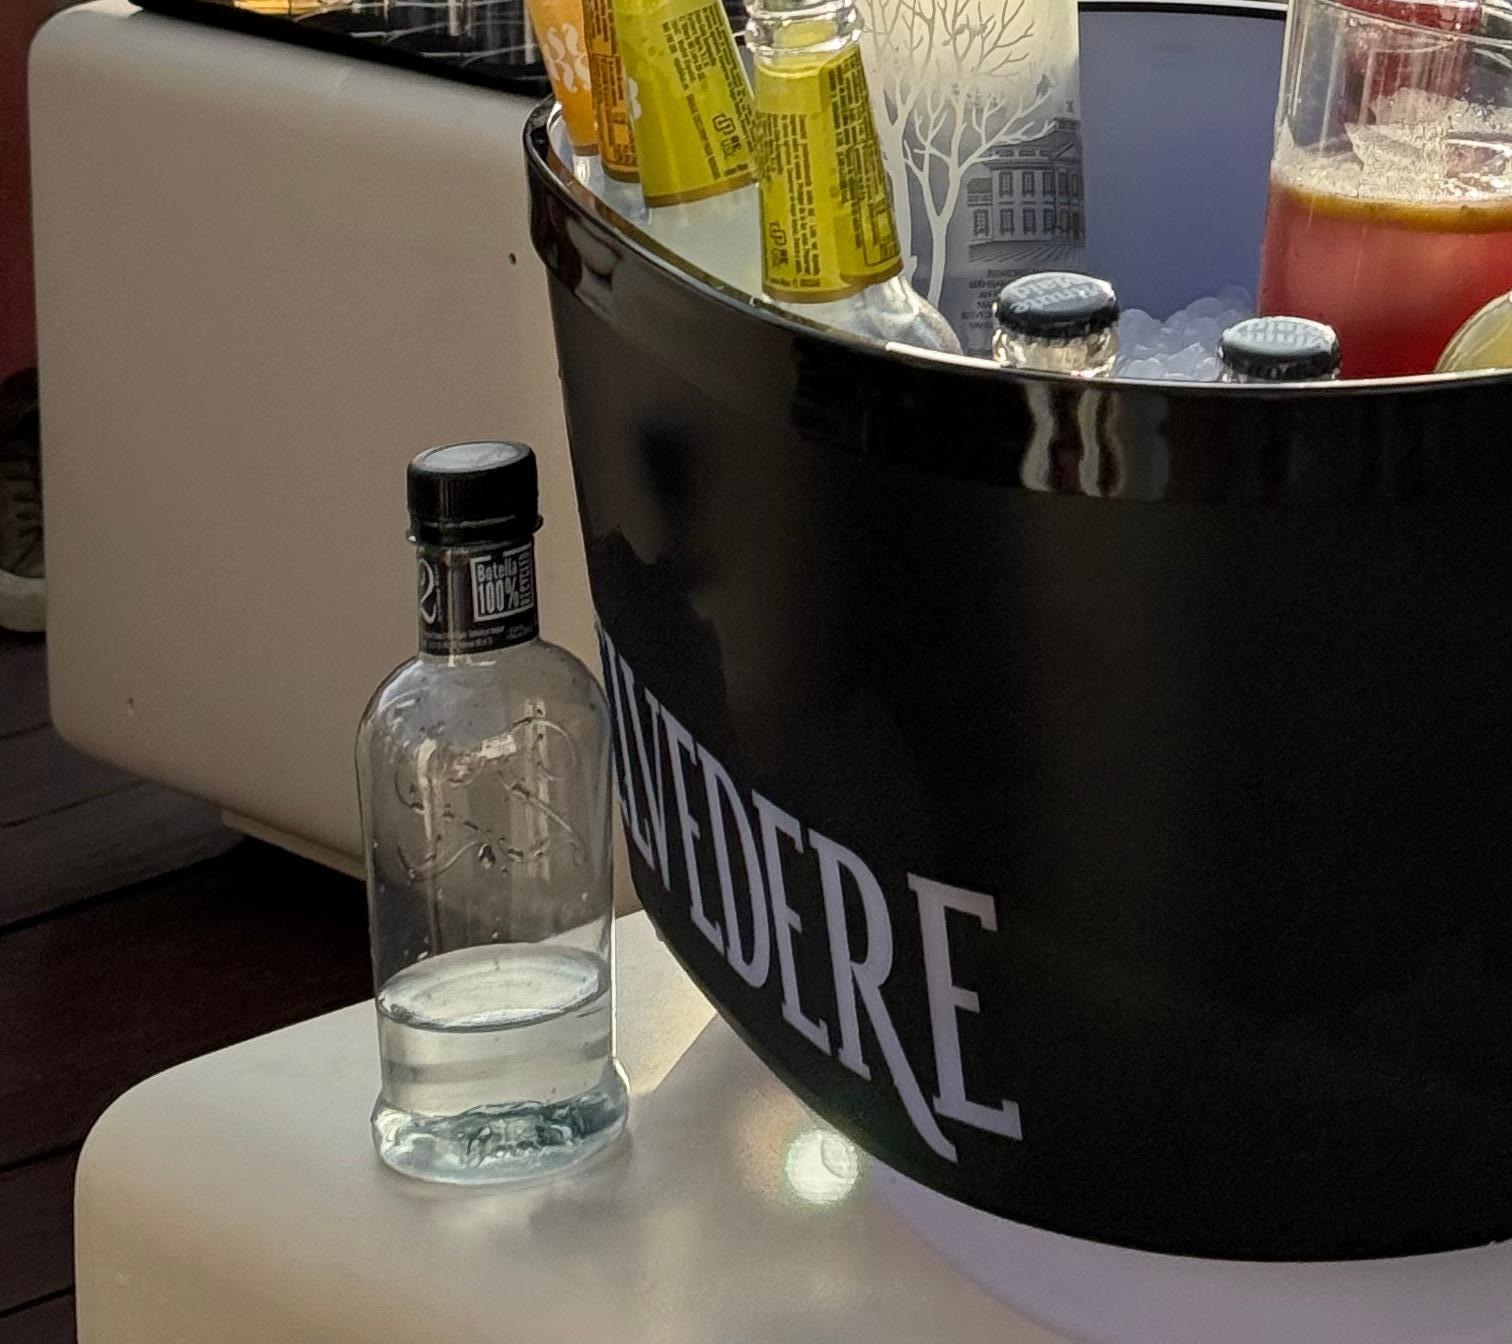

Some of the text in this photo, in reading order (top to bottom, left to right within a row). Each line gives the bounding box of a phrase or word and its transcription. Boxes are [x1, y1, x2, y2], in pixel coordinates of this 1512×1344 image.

[476, 556, 518, 582] Botella
[478, 576, 520, 614] 100%
[595, 610, 1023, 1164] LVEDERE
